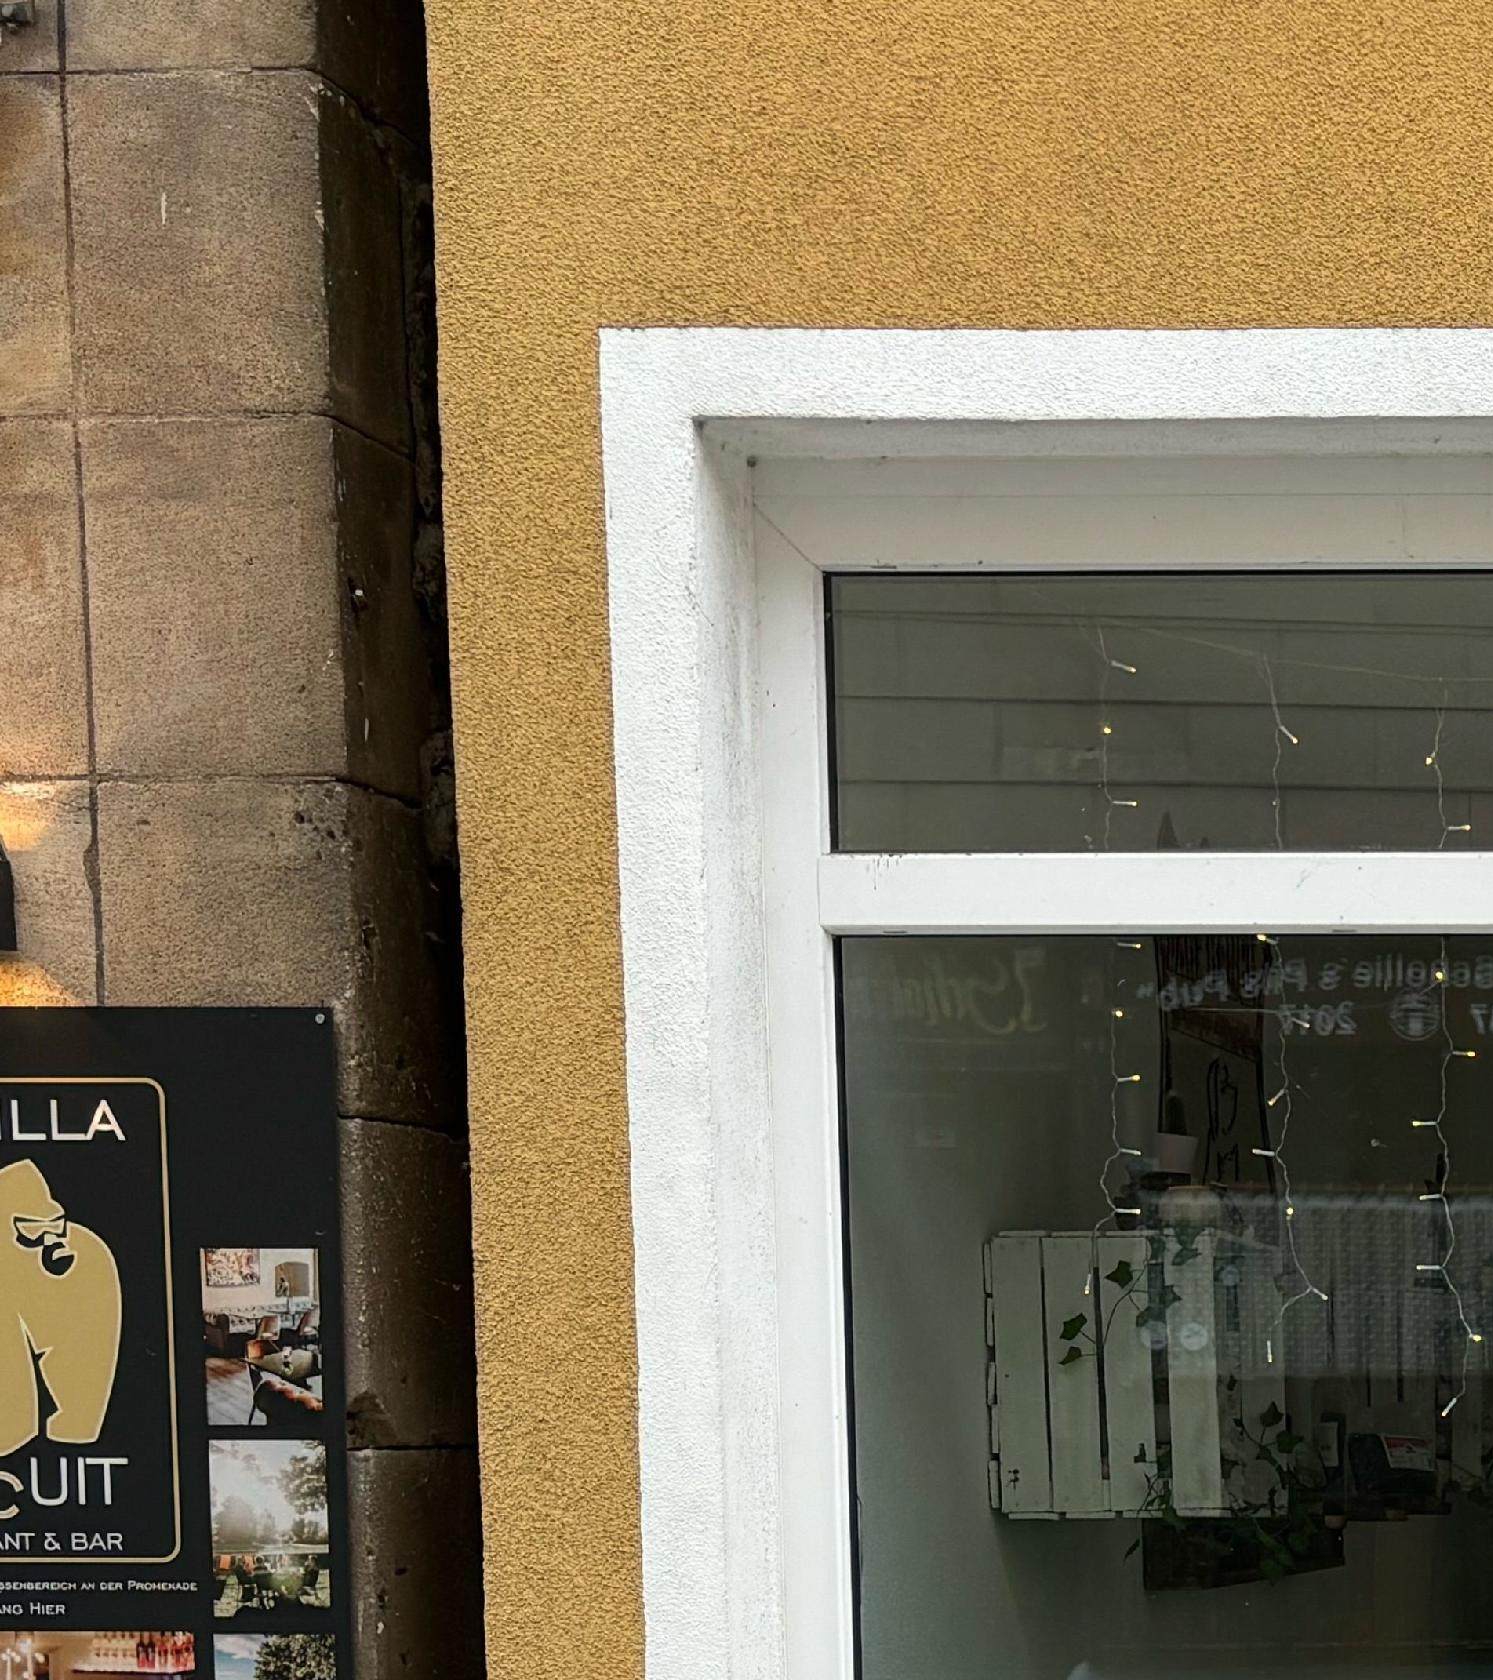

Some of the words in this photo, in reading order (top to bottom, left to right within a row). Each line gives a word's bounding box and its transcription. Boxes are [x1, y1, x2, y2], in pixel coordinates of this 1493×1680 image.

[0, 1098, 127, 1141] LLA
[44, 1532, 61, 1551] &
[70, 1532, 123, 1551] BAR
[29, 1601, 66, 1616] HIER
